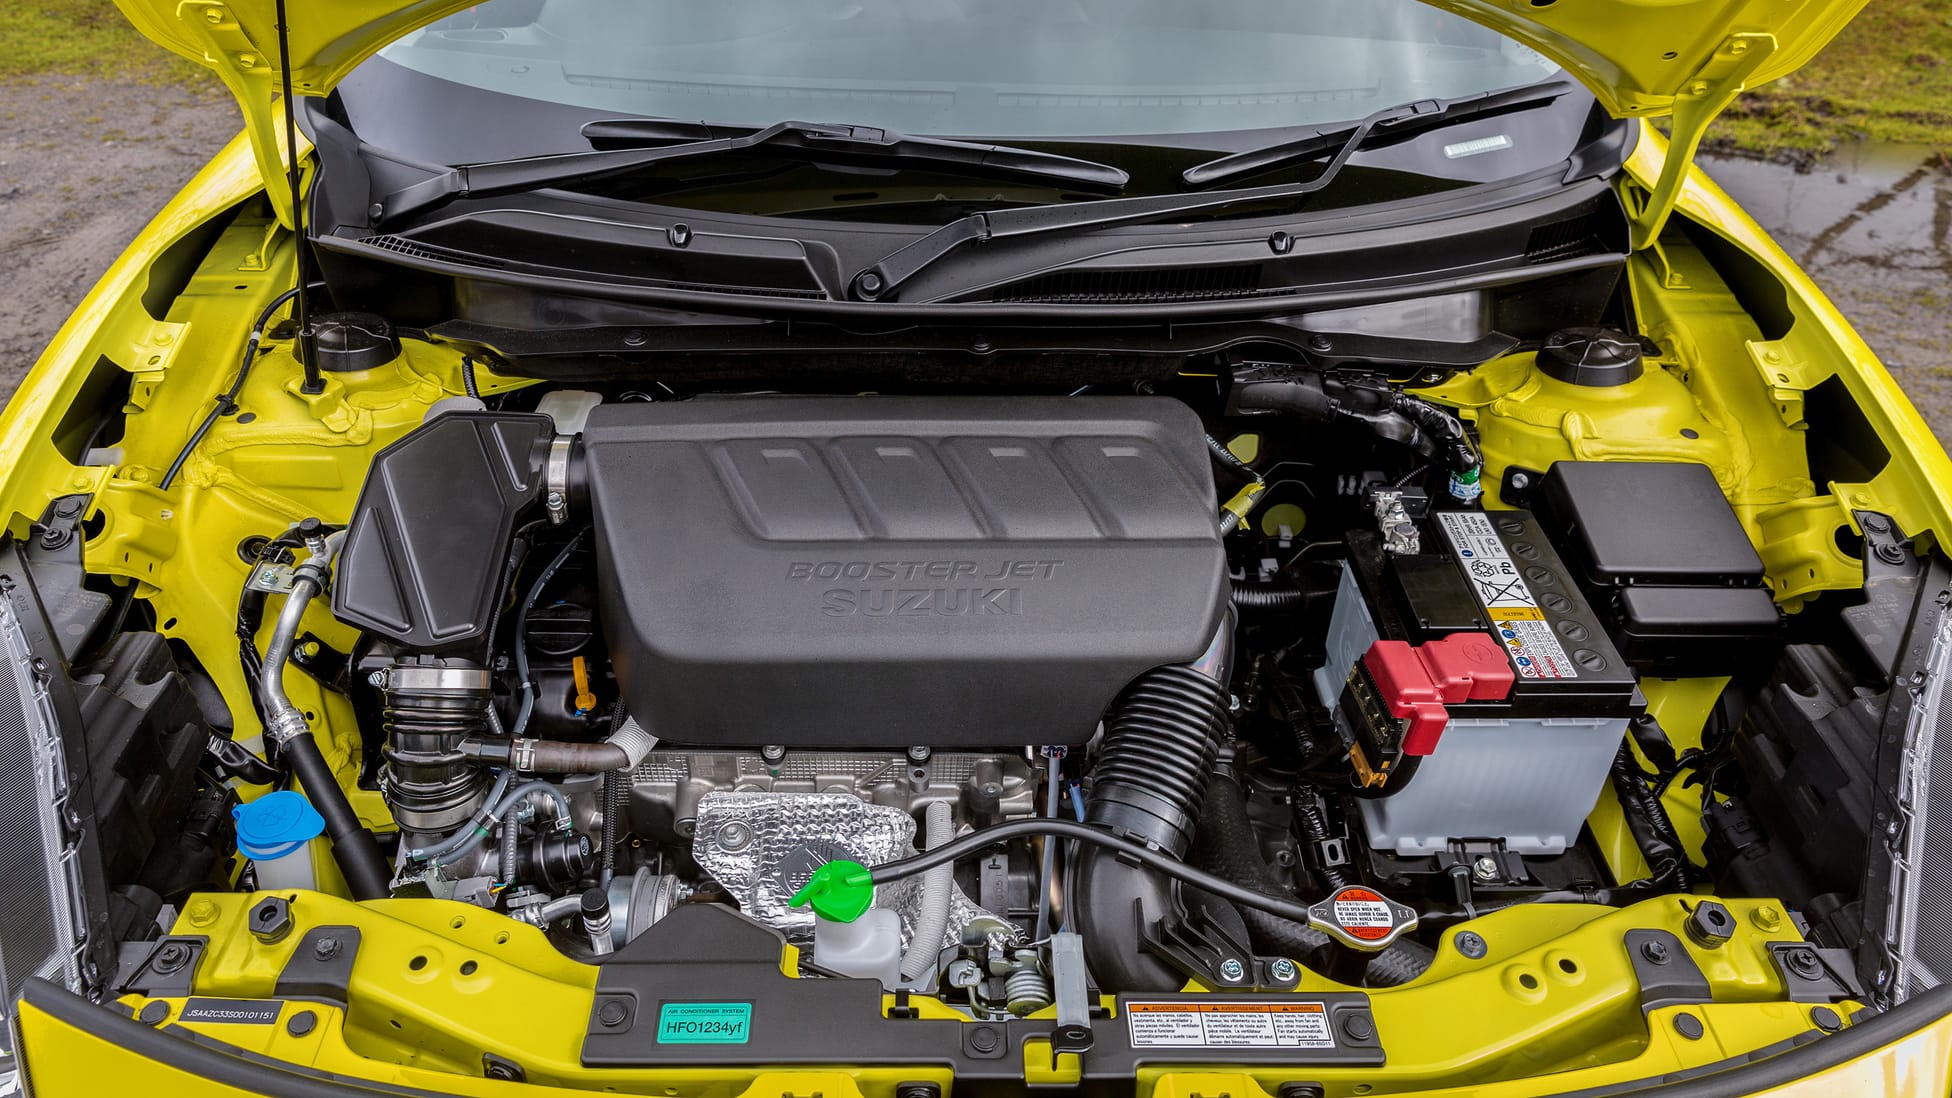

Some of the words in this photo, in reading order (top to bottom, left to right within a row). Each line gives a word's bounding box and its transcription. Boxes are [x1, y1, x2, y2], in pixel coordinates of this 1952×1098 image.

[785, 560, 978, 581] BOOSTER
[984, 560, 1064, 581] JET
[1500, 562, 1516, 574] Pb
[822, 588, 1024, 617] SUZUKI
[666, 1022, 743, 1035] HFO1234yf
